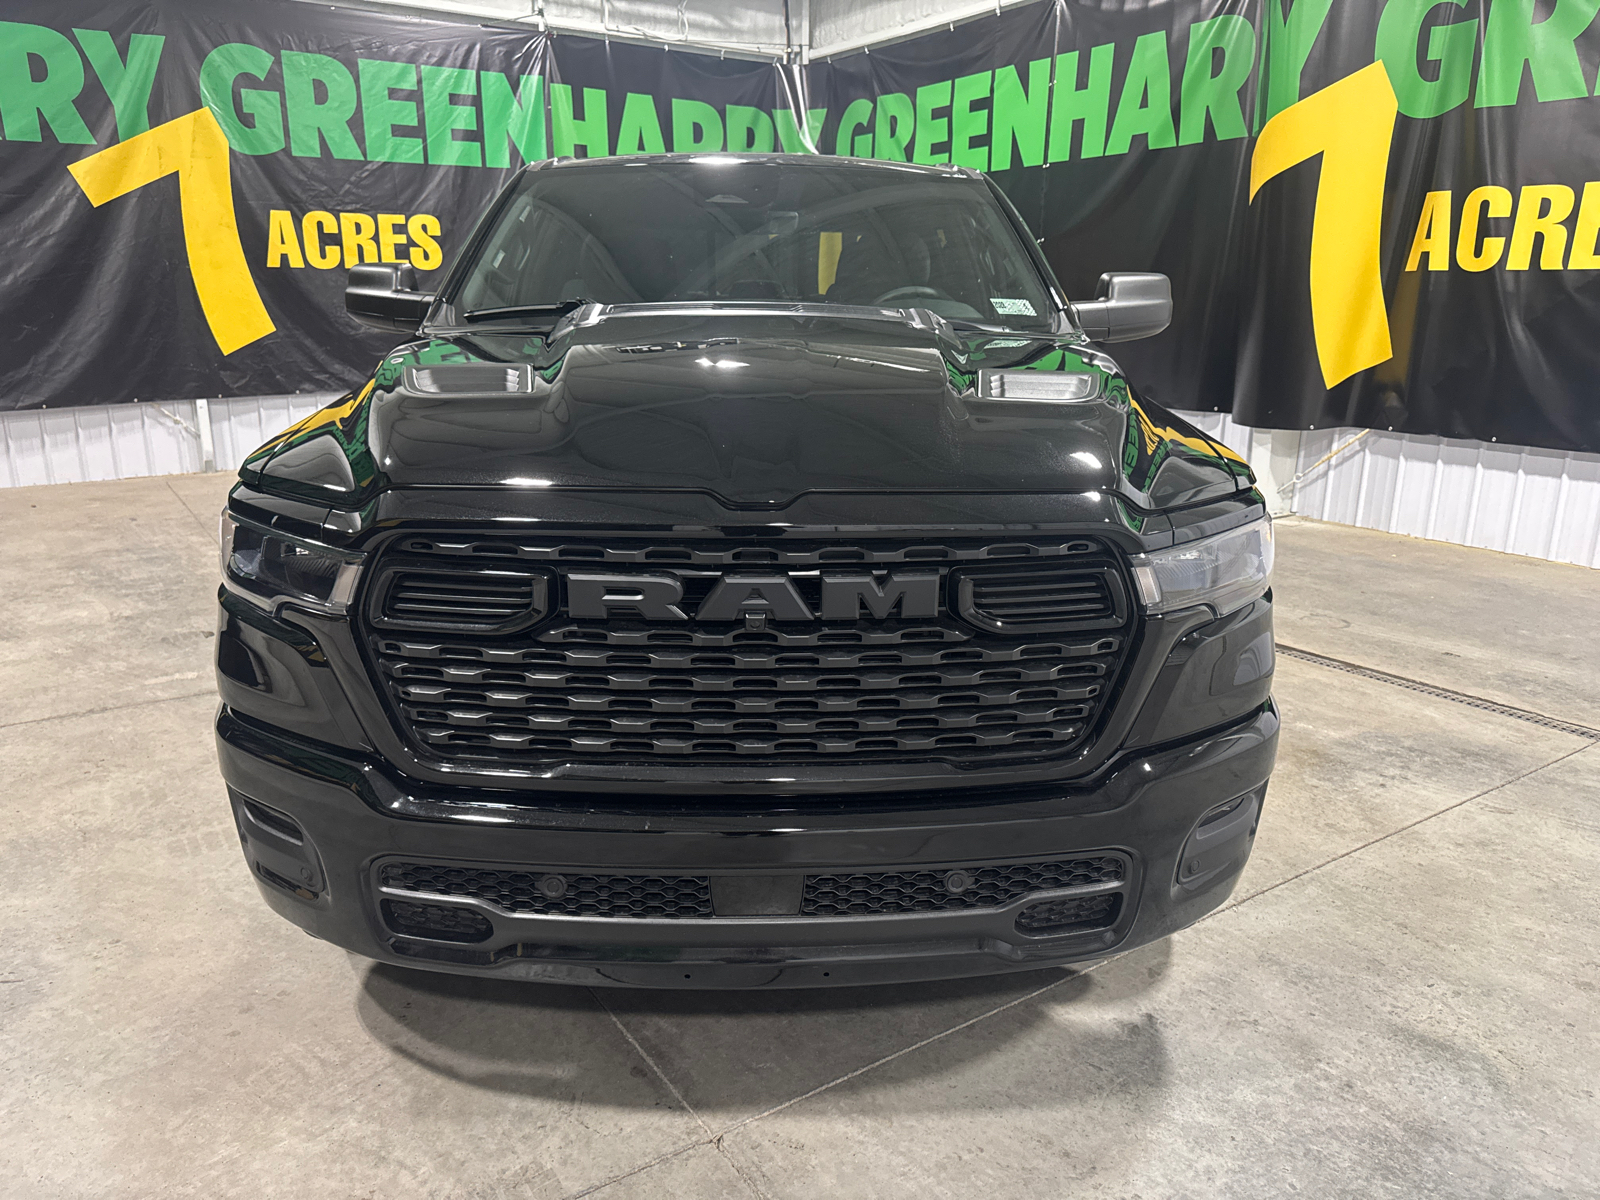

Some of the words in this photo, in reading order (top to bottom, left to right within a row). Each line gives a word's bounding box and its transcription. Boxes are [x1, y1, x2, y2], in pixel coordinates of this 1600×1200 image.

[0, 21, 166, 145] RY
[200, 43, 548, 169] GREEN
[836, 57, 1051, 173] GREEN
[1375, 0, 1600, 118] GR
[67, 106, 276, 356] 7
[267, 209, 443, 271] ACRES
[1249, 59, 1398, 390] 7
[567, 573, 941, 621] RAM
